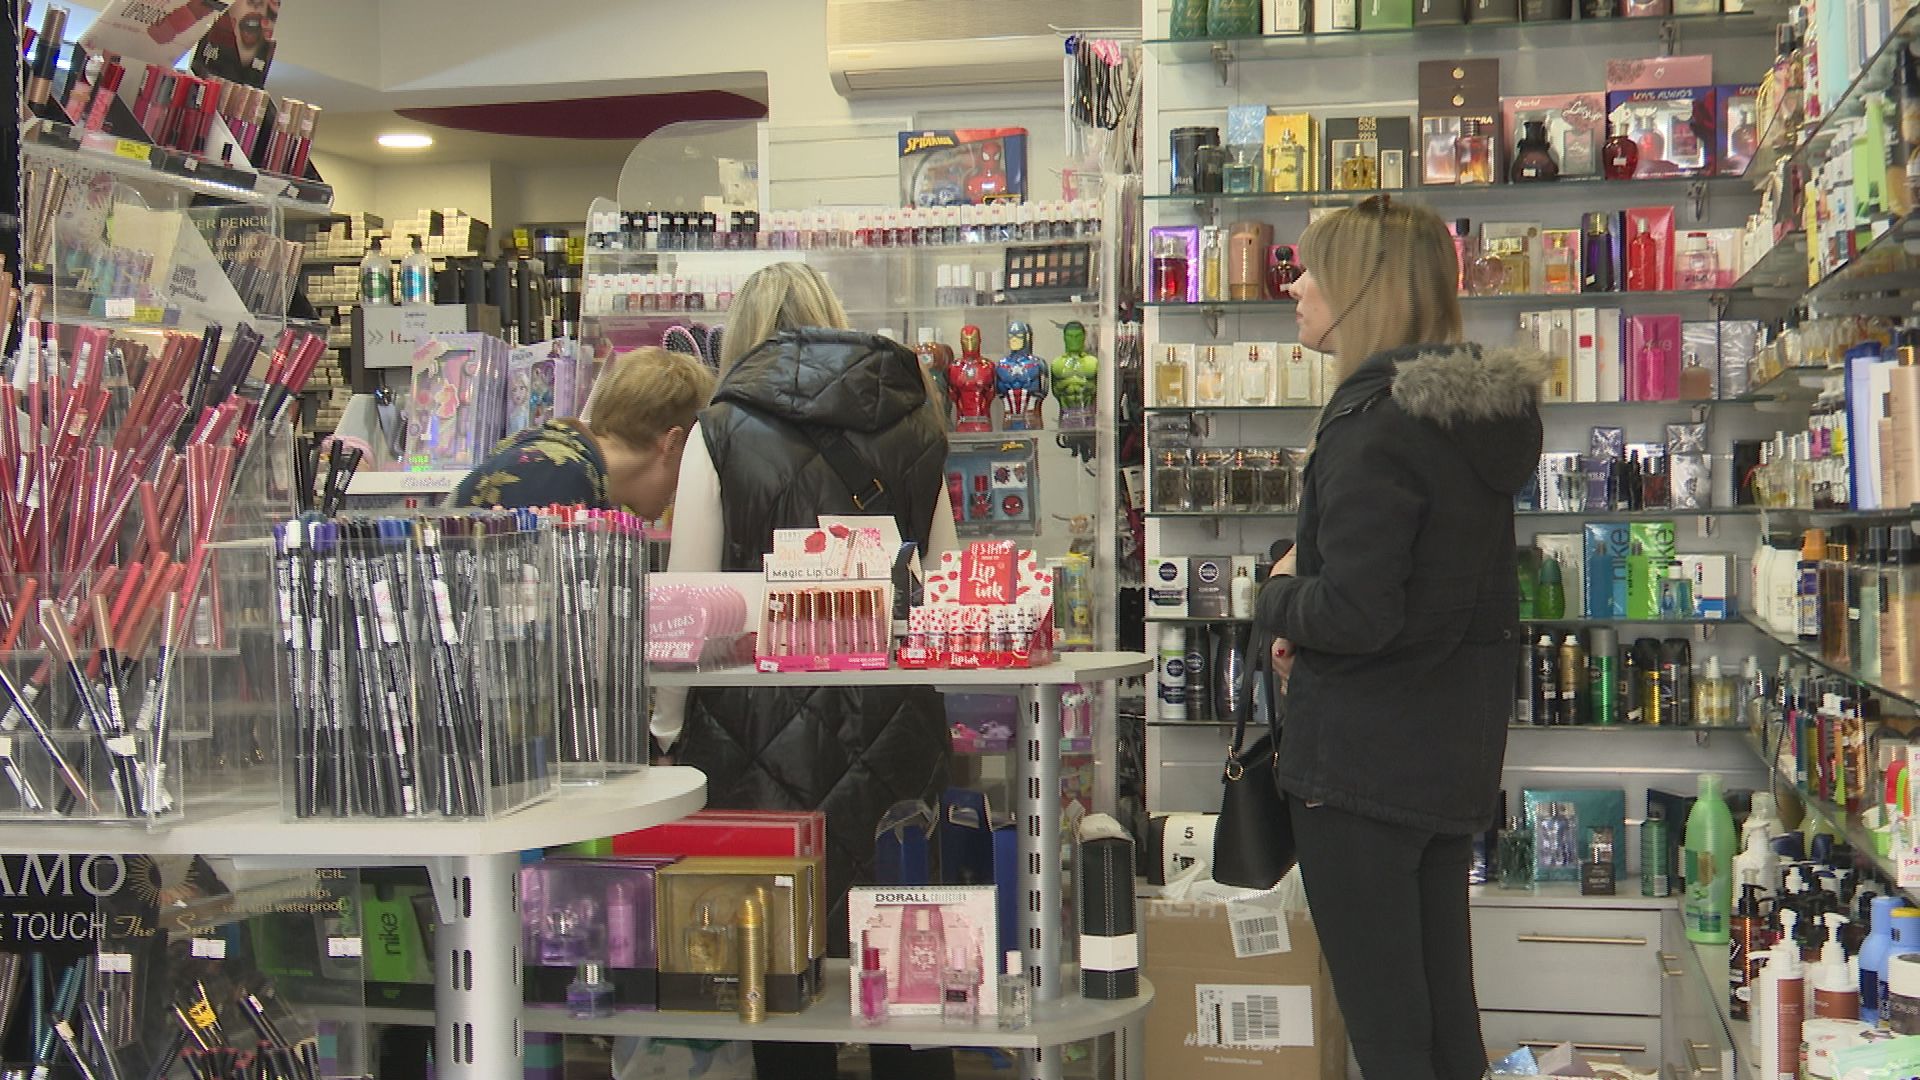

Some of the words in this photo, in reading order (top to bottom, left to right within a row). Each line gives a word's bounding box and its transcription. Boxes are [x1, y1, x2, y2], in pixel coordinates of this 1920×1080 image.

[1611, 528, 1630, 582] nike
[772, 569, 803, 580] Magic
[806, 568, 822, 578] Lip
[825, 567, 840, 577] Oil
[968, 559, 995, 584] Lip
[975, 580, 1006, 602] ink
[1184, 827, 1195, 839] 5
[876, 893, 928, 902] DORALL
[13, 913, 107, 940] TOUCH
[112, 914, 156, 938] The
[175, 912, 217, 936] Sun
[380, 913, 401, 956] nike
